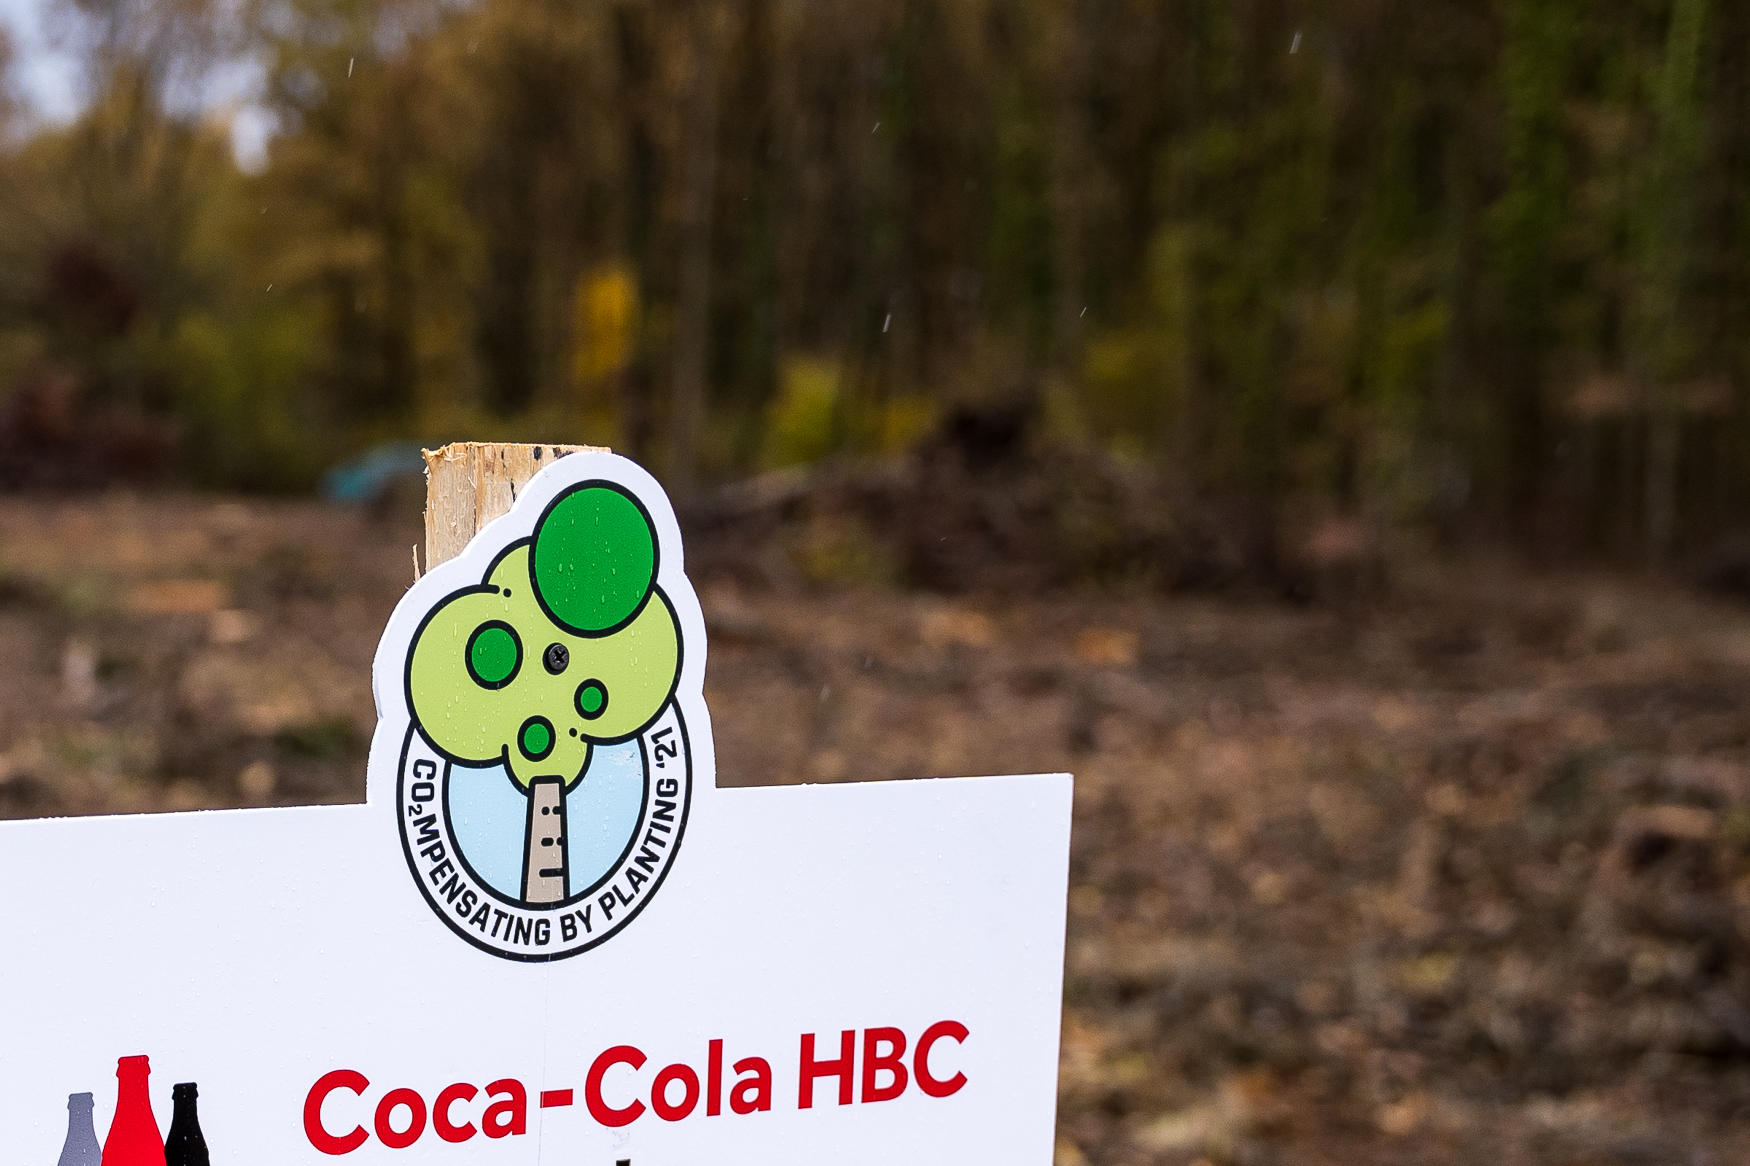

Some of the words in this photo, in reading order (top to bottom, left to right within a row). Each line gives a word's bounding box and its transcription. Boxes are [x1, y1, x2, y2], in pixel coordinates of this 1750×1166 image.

[560, 904, 593, 942] BY
[598, 778, 678, 921] PLANTING
[303, 1040, 772, 1155] Coca-Cola
[798, 1020, 969, 1110] HBC
